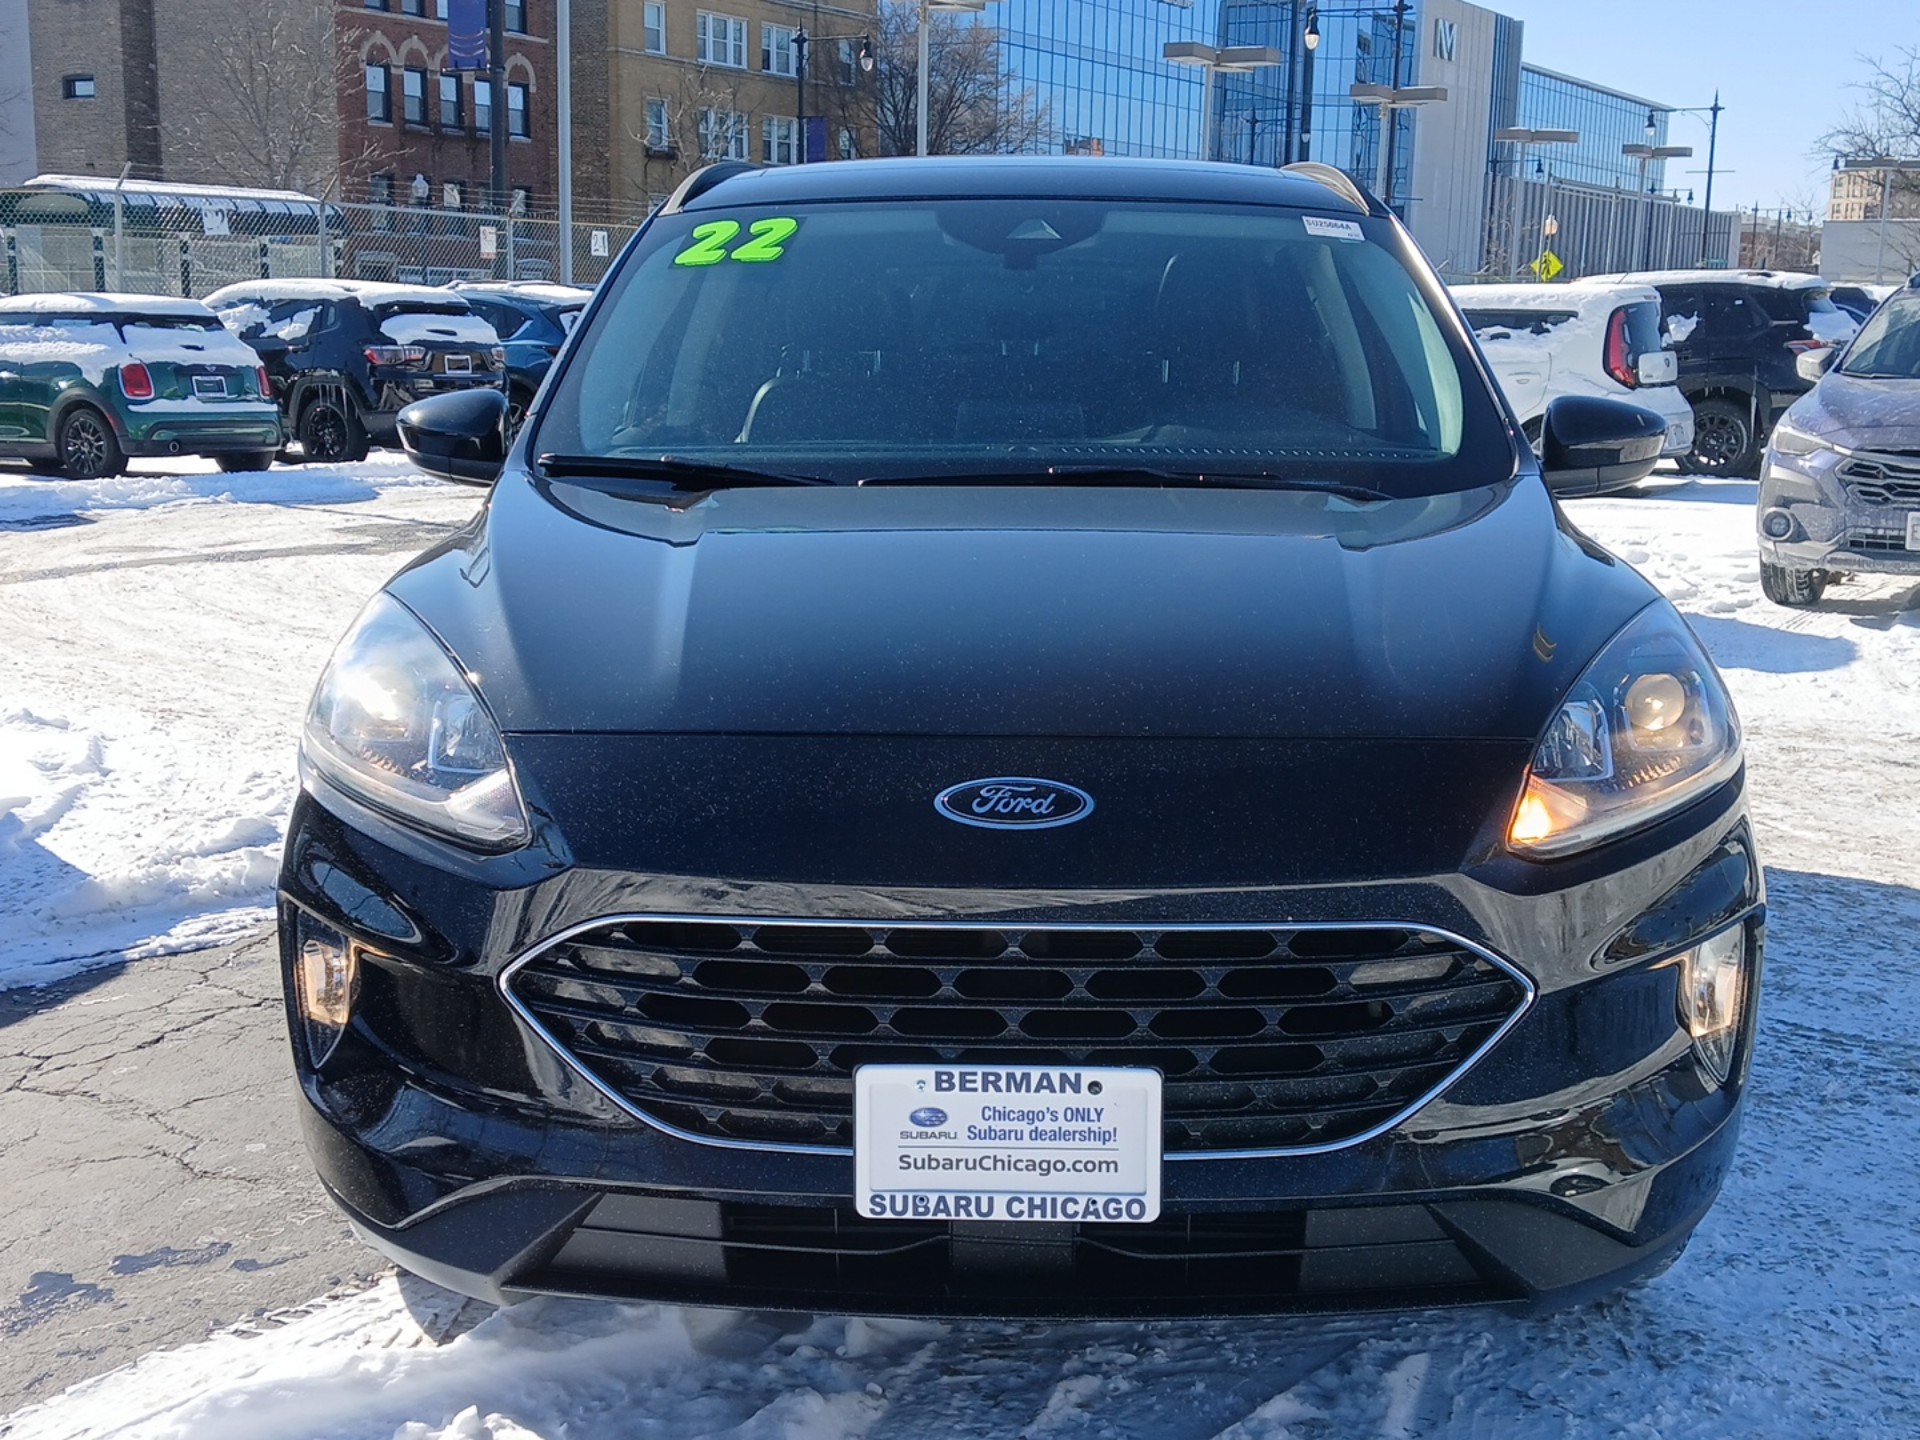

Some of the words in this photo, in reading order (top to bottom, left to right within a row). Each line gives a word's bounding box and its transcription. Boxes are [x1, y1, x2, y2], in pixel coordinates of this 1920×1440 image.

[673, 216, 799, 267] 22
[971, 784, 1057, 815] Ford
[934, 1070, 1082, 1094] BERMAN
[980, 1105, 1060, 1123] Chicago's
[1063, 1107, 1104, 1123] ONLY
[899, 1130, 957, 1140] SUBARU
[967, 1125, 1025, 1142] Subaru
[1028, 1126, 1118, 1146] dealership!
[898, 1154, 1119, 1177] SubaruChicago.com
[869, 1194, 995, 1218] SUBARU
[1006, 1196, 1147, 1220] CHICAGO
